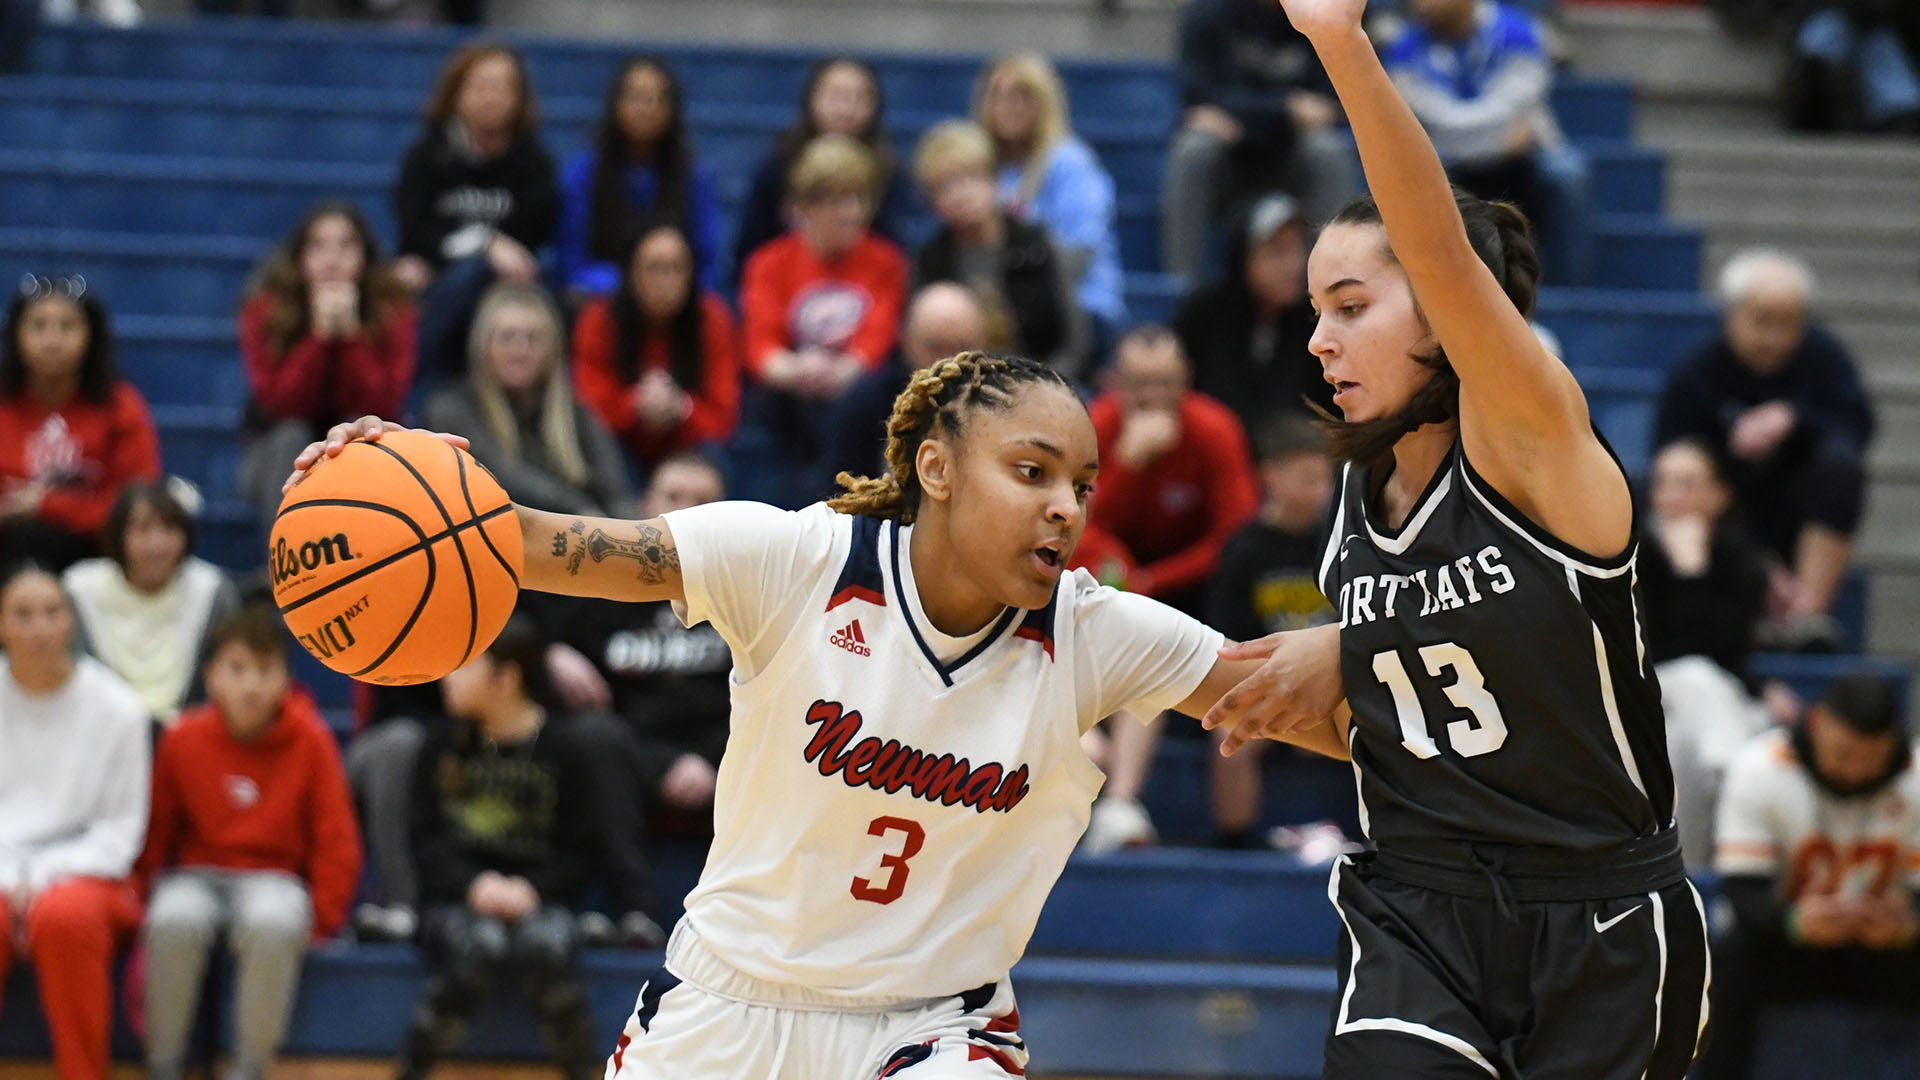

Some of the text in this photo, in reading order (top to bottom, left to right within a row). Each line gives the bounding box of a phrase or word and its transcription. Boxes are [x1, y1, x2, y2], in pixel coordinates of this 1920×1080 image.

[271, 533, 354, 585] ilson
[344, 595, 370, 621] NXT
[1339, 574, 1408, 630] ORT
[830, 635, 871, 657] adidas
[1372, 642, 1508, 759] 13
[804, 699, 1029, 813] Newman
[850, 815, 926, 905] 3
